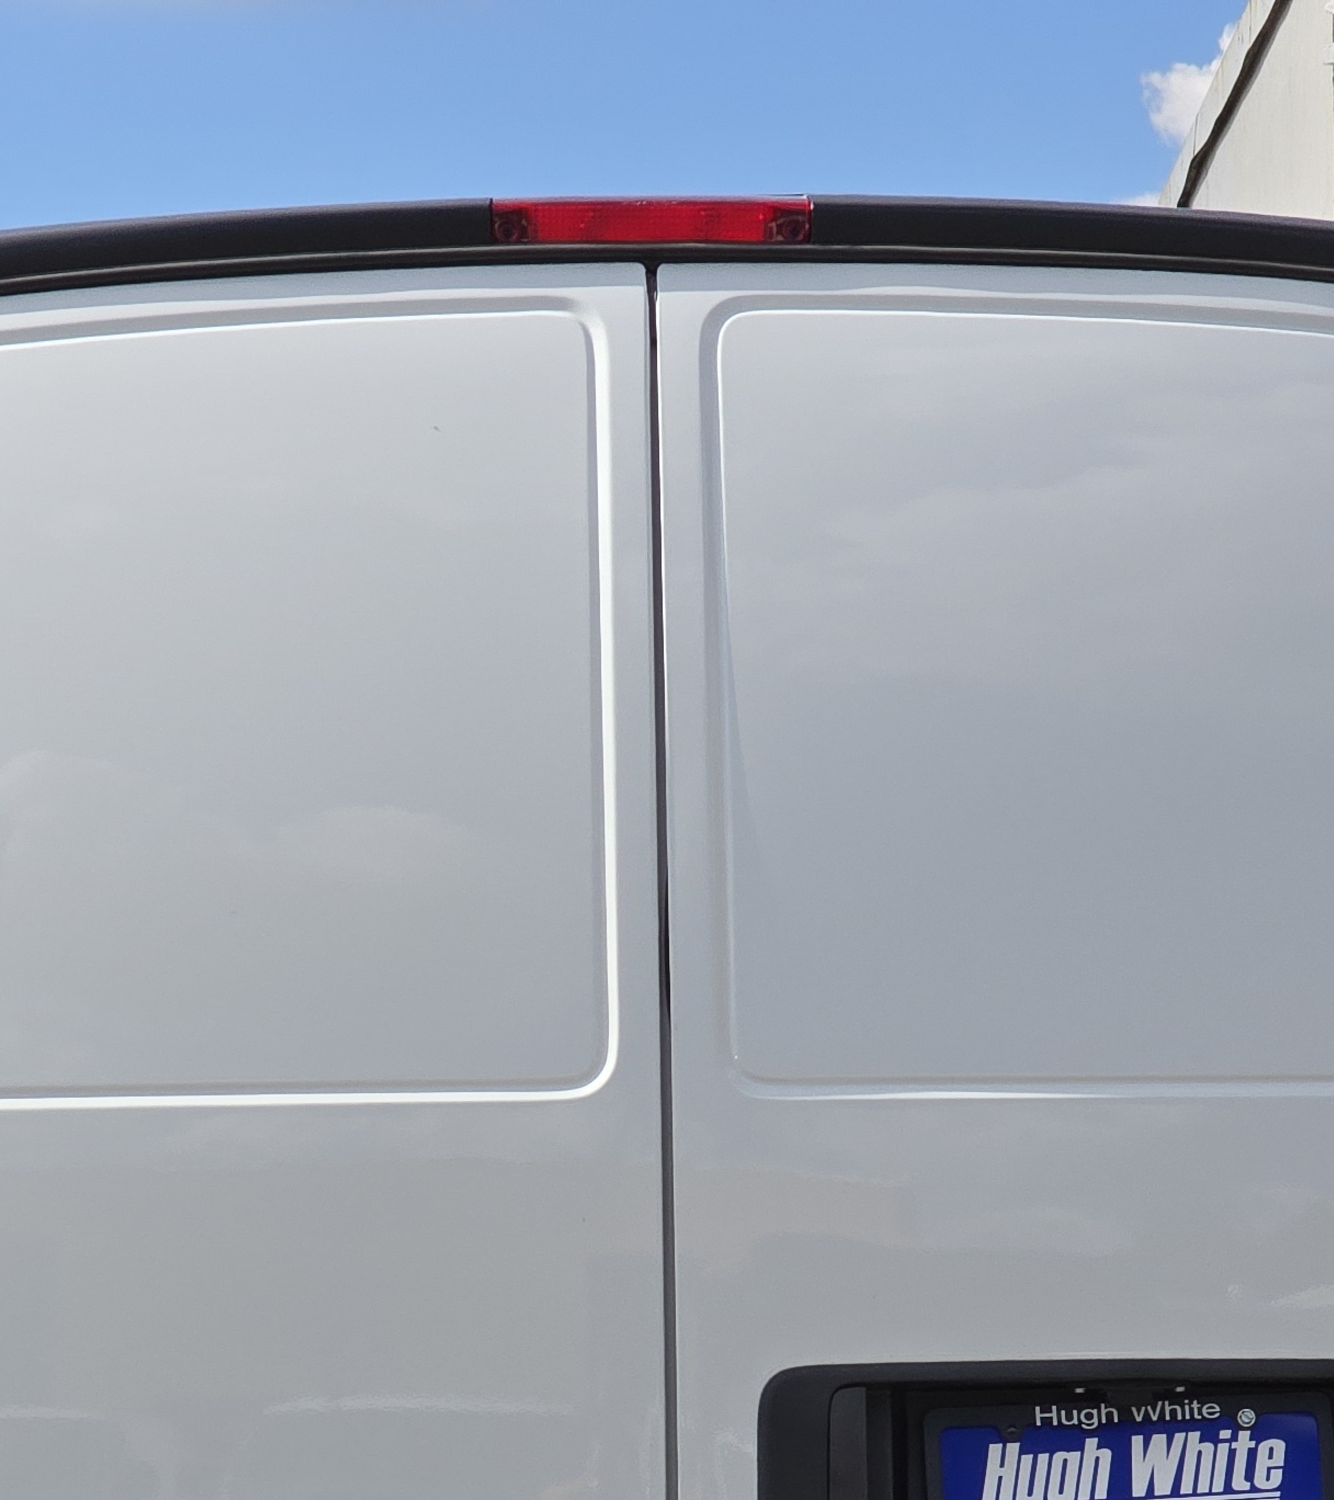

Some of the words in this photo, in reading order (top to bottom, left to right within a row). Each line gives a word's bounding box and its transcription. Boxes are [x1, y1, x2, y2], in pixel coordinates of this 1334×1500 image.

[1034, 1403, 1119, 1430] Hugh
[1131, 1399, 1221, 1422] White
[1131, 1429, 1286, 1498] White
